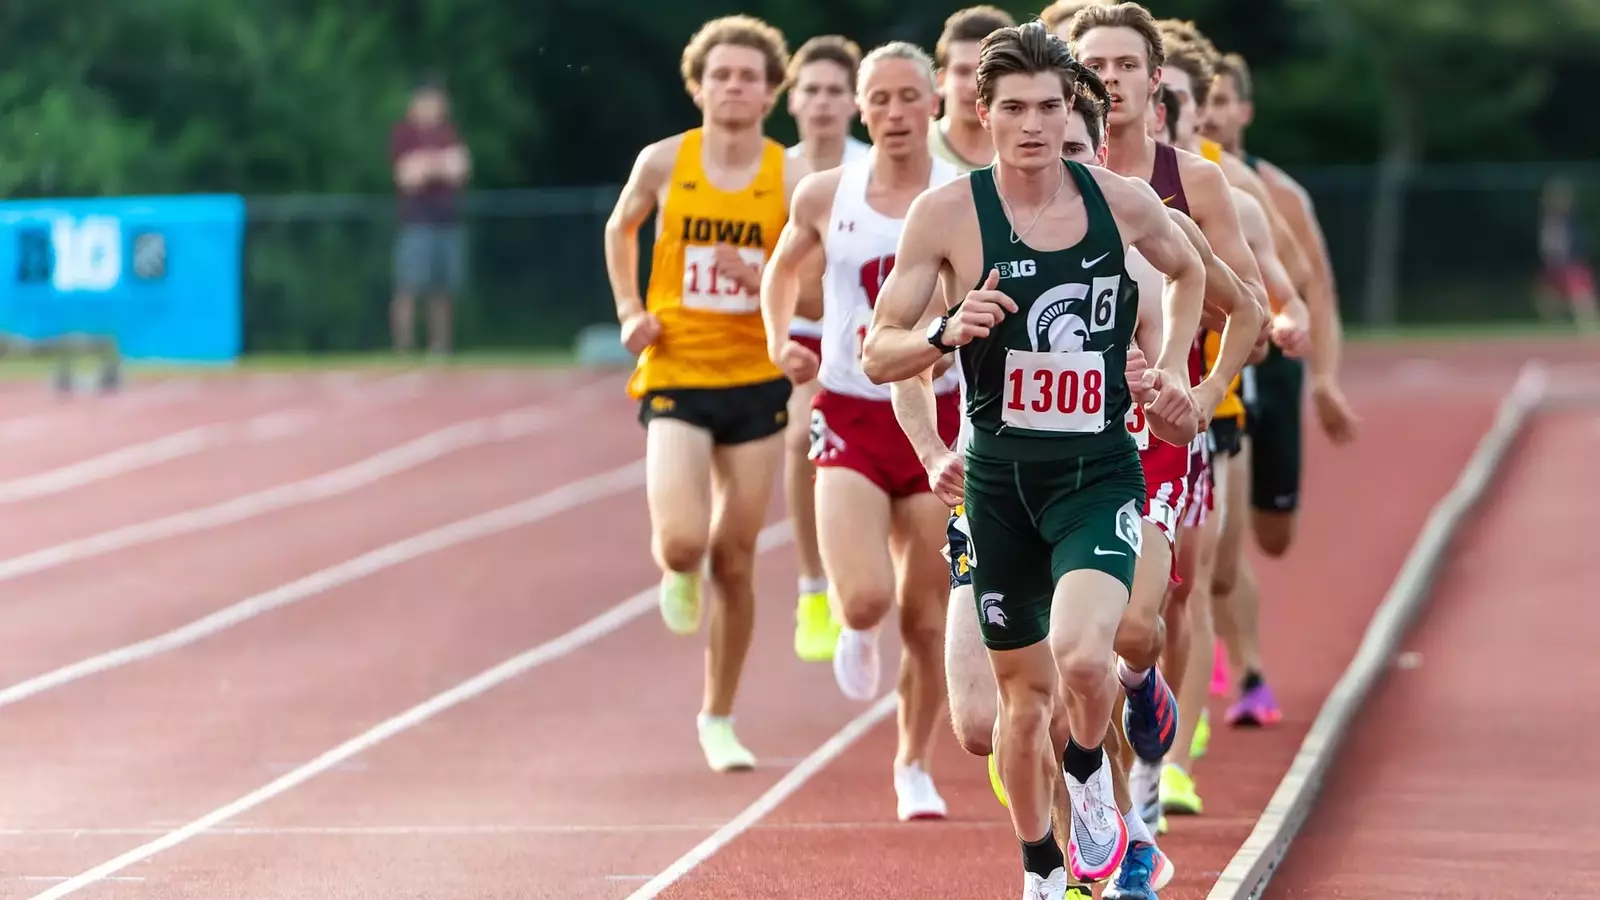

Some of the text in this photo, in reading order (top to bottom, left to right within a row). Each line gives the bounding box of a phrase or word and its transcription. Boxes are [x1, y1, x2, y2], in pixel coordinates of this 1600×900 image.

[682, 216, 764, 247] IOWA
[1095, 288, 1113, 326] 6
[1007, 368, 1102, 414] 1308
